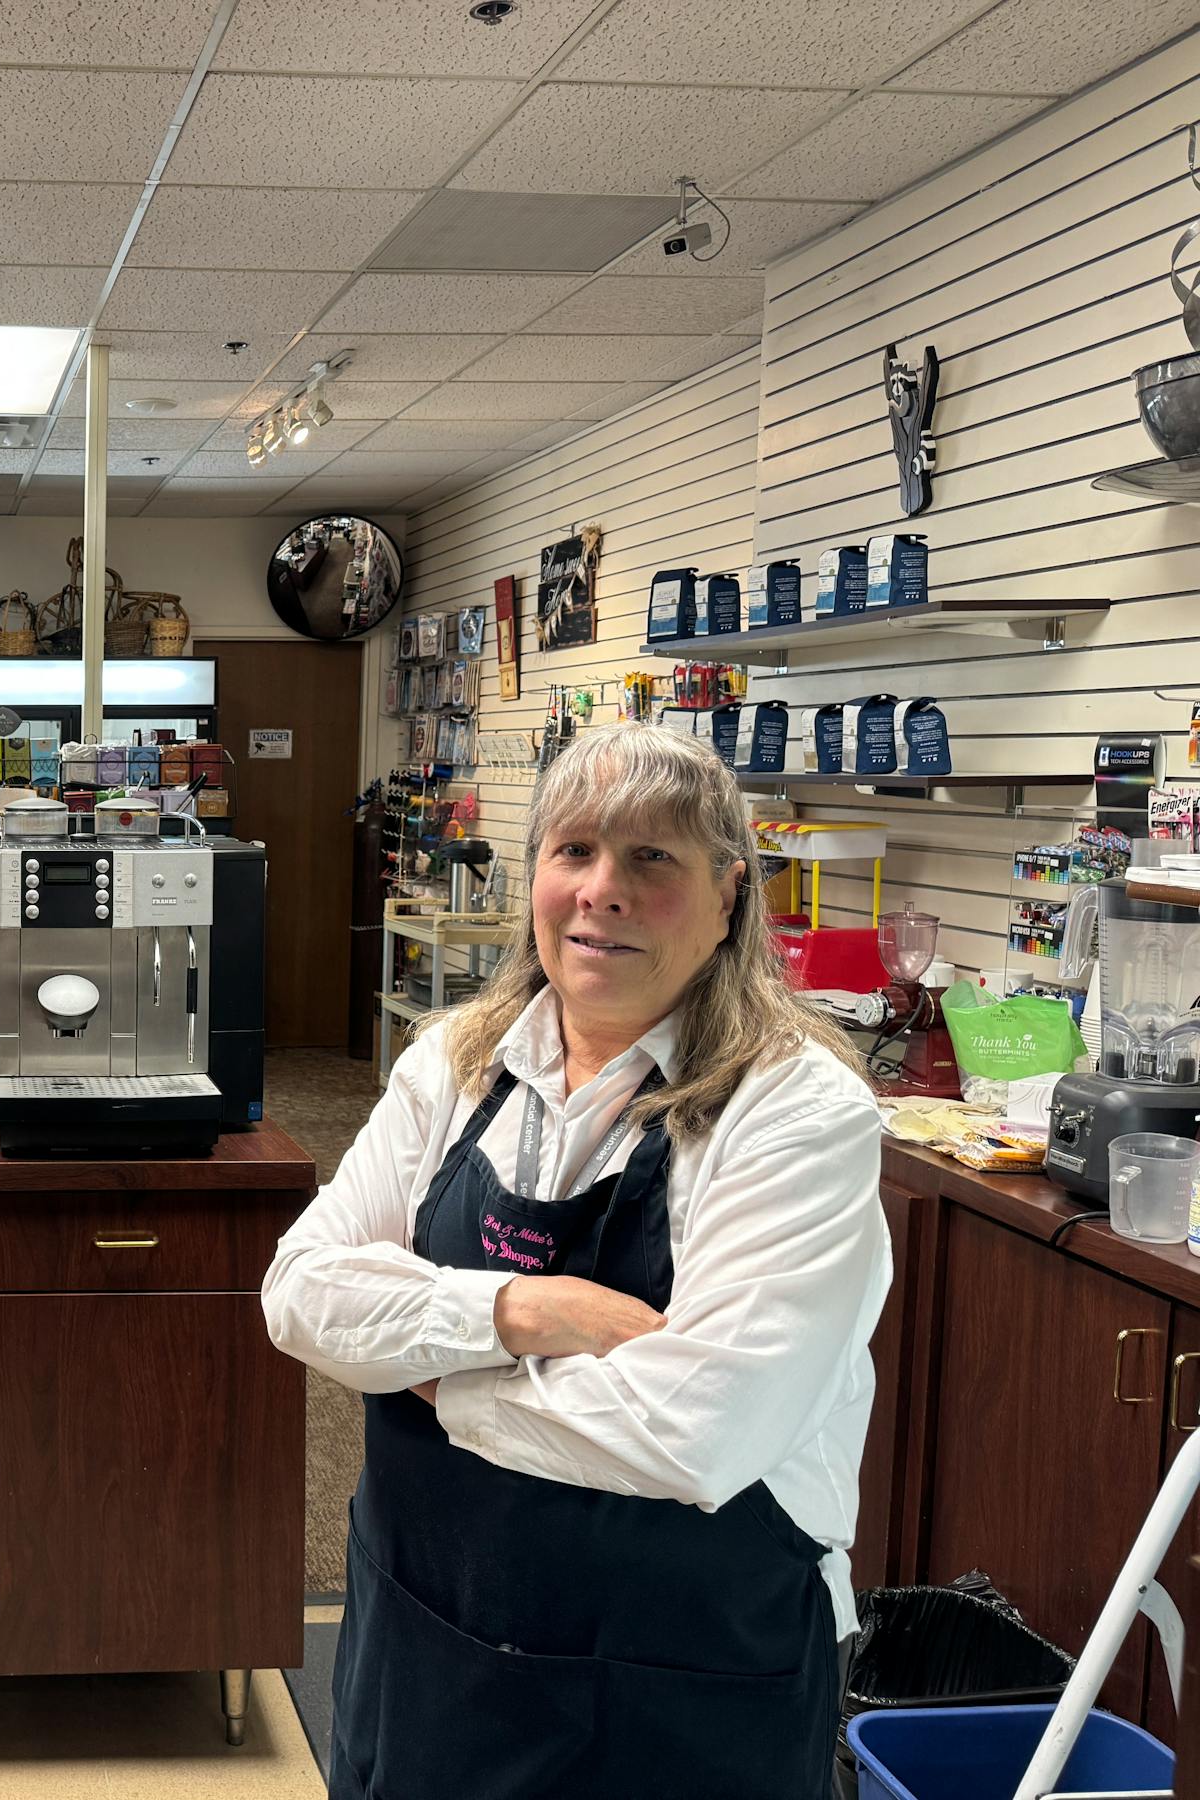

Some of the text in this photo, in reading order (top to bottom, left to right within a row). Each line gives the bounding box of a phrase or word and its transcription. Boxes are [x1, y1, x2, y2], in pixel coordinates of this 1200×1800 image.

[254, 732, 289, 741] NOTICE
[1110, 750, 1150, 759] HOOKUPS
[1150, 797, 1191, 815] Energizer
[970, 1035, 1039, 1051] Thank You
[522, 1123, 534, 1155] center
[595, 1121, 629, 1161] securian
[483, 1213, 502, 1232] Pat
[513, 1227, 554, 1247] Mike's
[498, 1240, 545, 1270] Shoppe,
